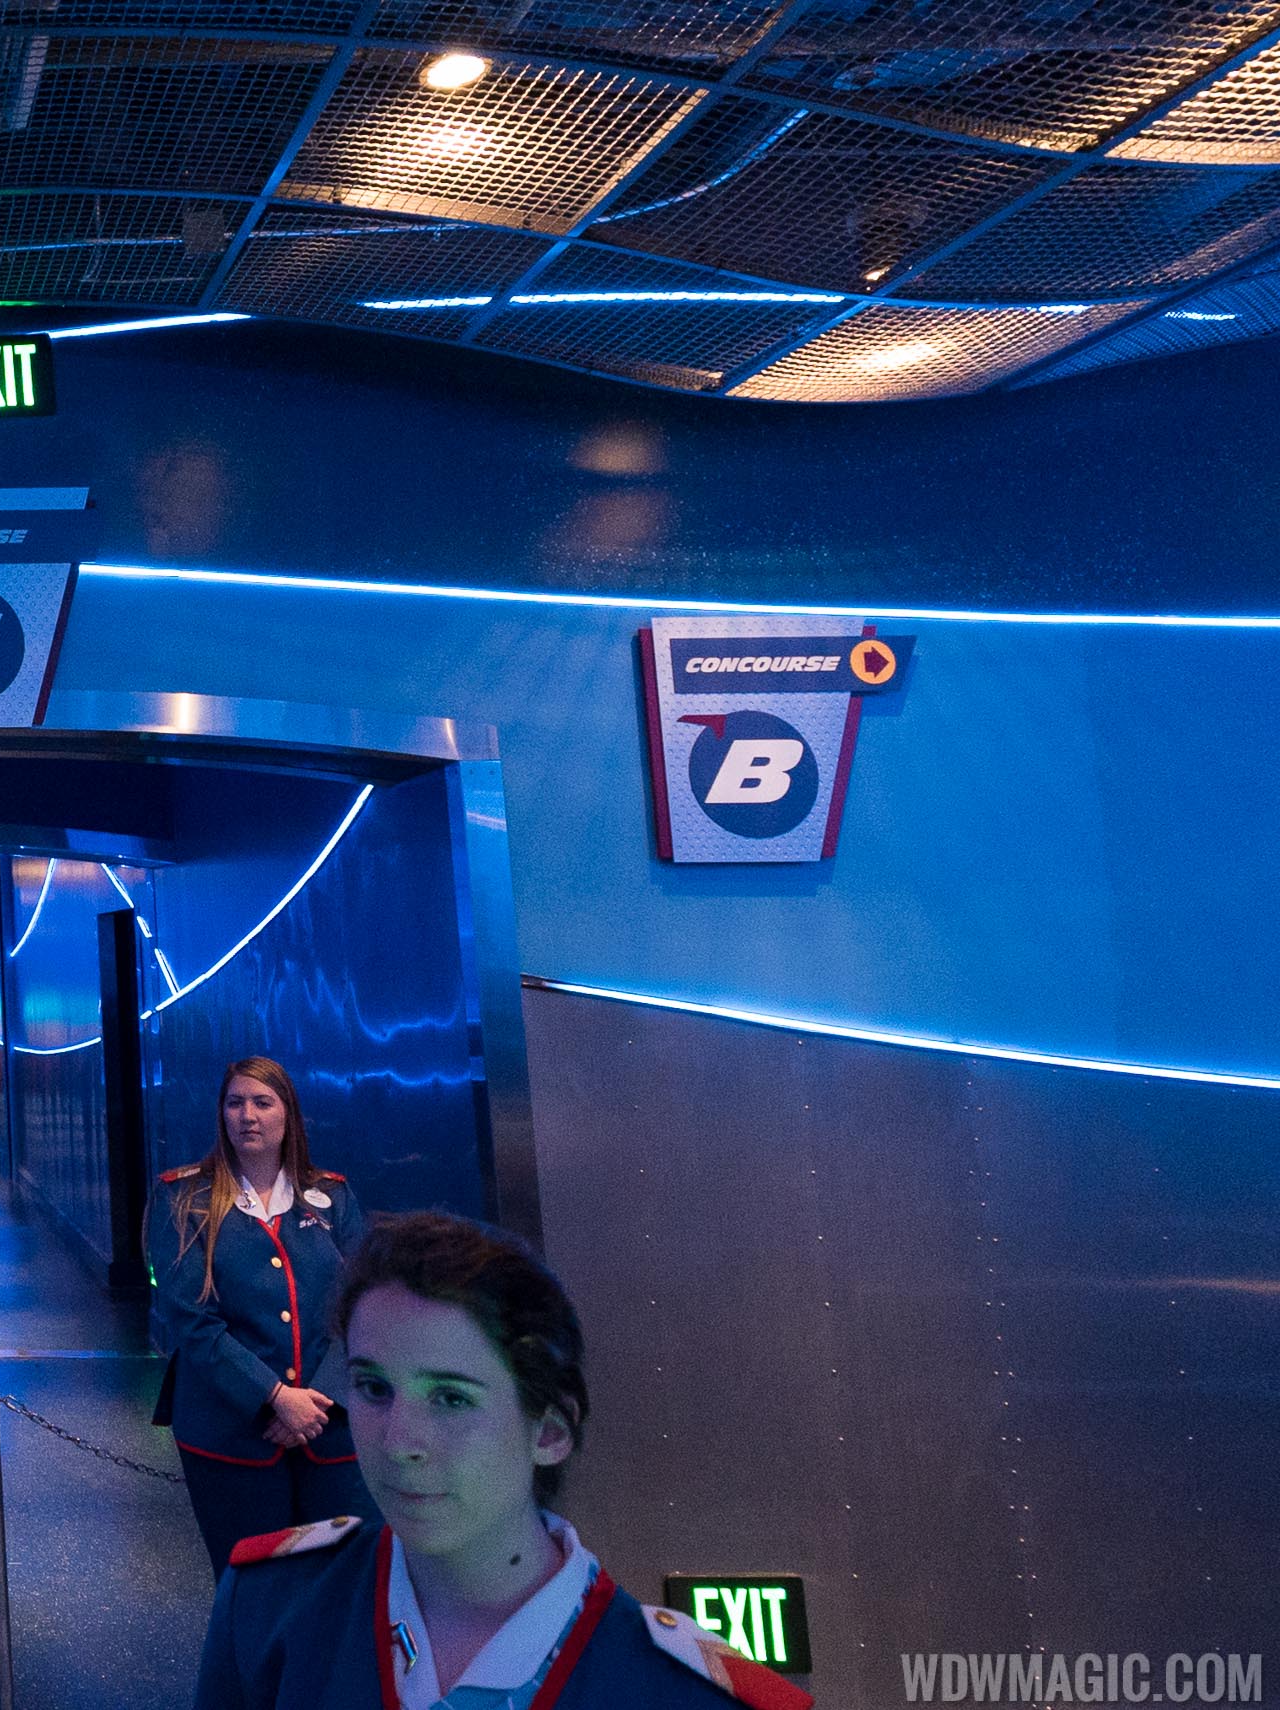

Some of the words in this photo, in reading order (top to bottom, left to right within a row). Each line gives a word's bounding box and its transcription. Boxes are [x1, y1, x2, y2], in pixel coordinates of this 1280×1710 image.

[685, 655, 841, 673] CONCOURSE
[704, 738, 804, 804] B
[693, 1587, 787, 1662] EXIT
